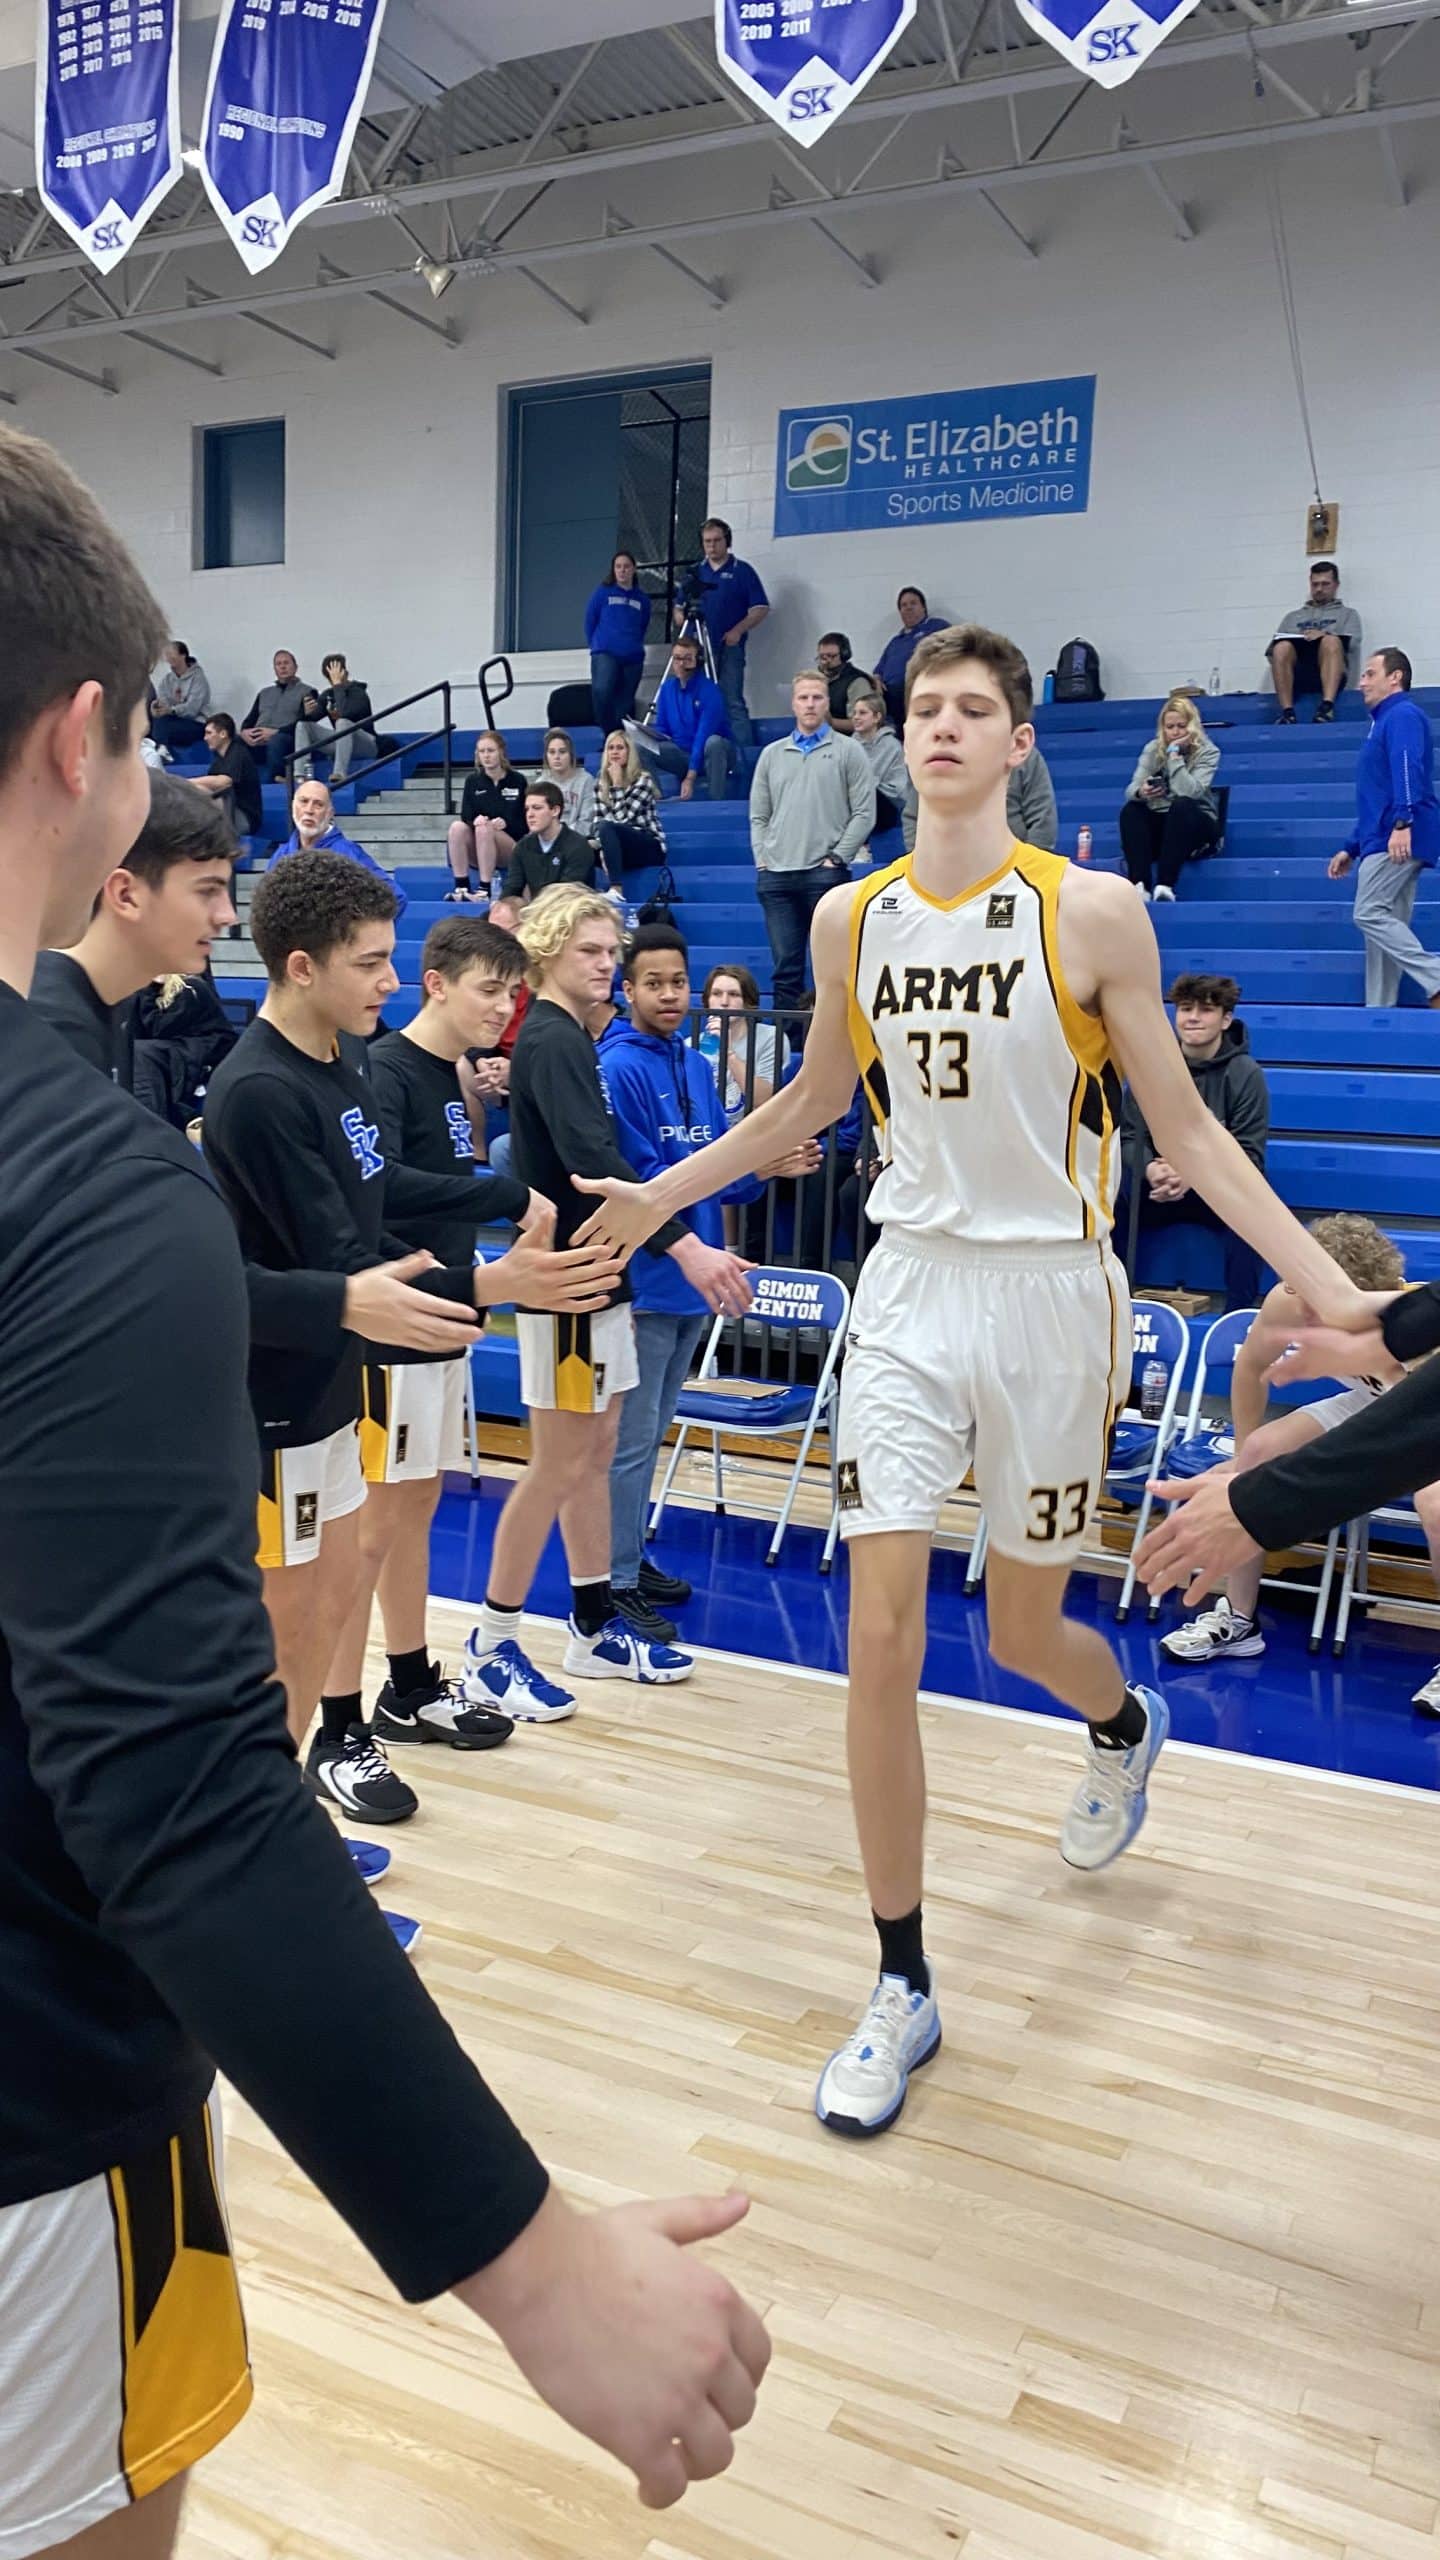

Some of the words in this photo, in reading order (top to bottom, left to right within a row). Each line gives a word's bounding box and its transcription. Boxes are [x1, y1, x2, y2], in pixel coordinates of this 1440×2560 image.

[301, 1, 330, 20] 2015
[334, 8, 362, 28] 2016
[739, 3, 775, 19] 2005
[780, 17, 811, 38] 2011
[1087, 23, 1141, 65] SK
[787, 84, 835, 122] SK
[91, 220, 125, 251] SK
[241, 216, 278, 249] SK
[855, 427, 898, 465] St.
[905, 407, 1079, 461] Elizabeth
[904, 448, 1077, 479] HEALTHCARE
[887, 491, 961, 519] Sports
[969, 480, 1074, 509] Medicine
[872, 957, 1025, 1021] ARMY
[906, 1029, 970, 1099] 33
[756, 1278, 820, 1301] SIMON
[749, 1296, 825, 1320] KENTON
[1026, 1478, 1090, 1541] 33
